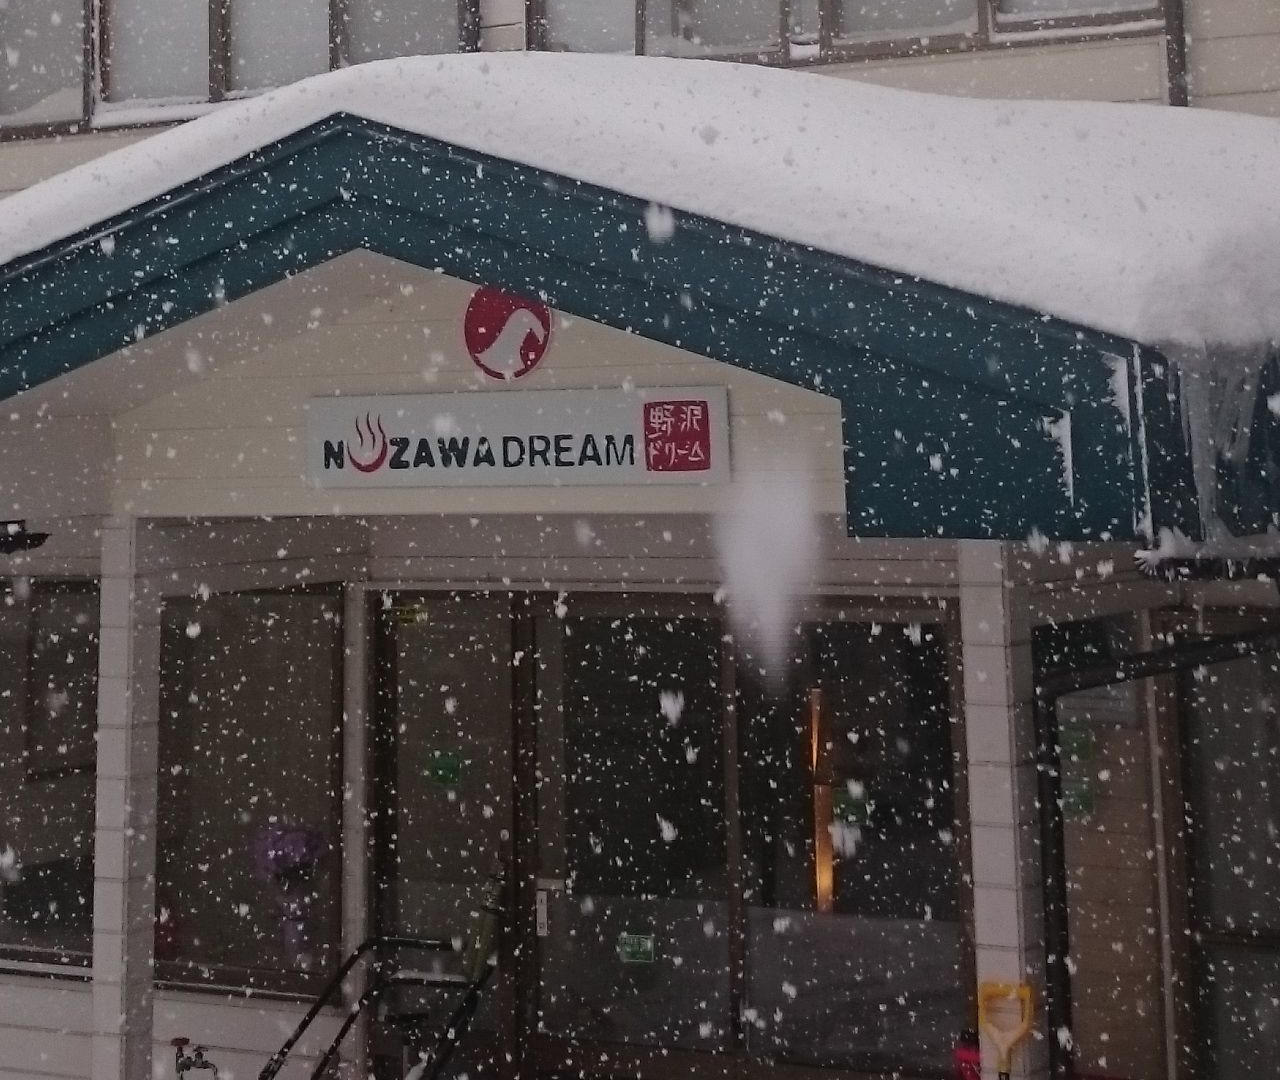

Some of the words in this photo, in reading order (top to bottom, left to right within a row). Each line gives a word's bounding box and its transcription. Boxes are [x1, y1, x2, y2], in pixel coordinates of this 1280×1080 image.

[649, 404, 703, 437] 野沢
[502, 434, 635, 468] DREAM
[648, 439, 705, 467] ドリーム
